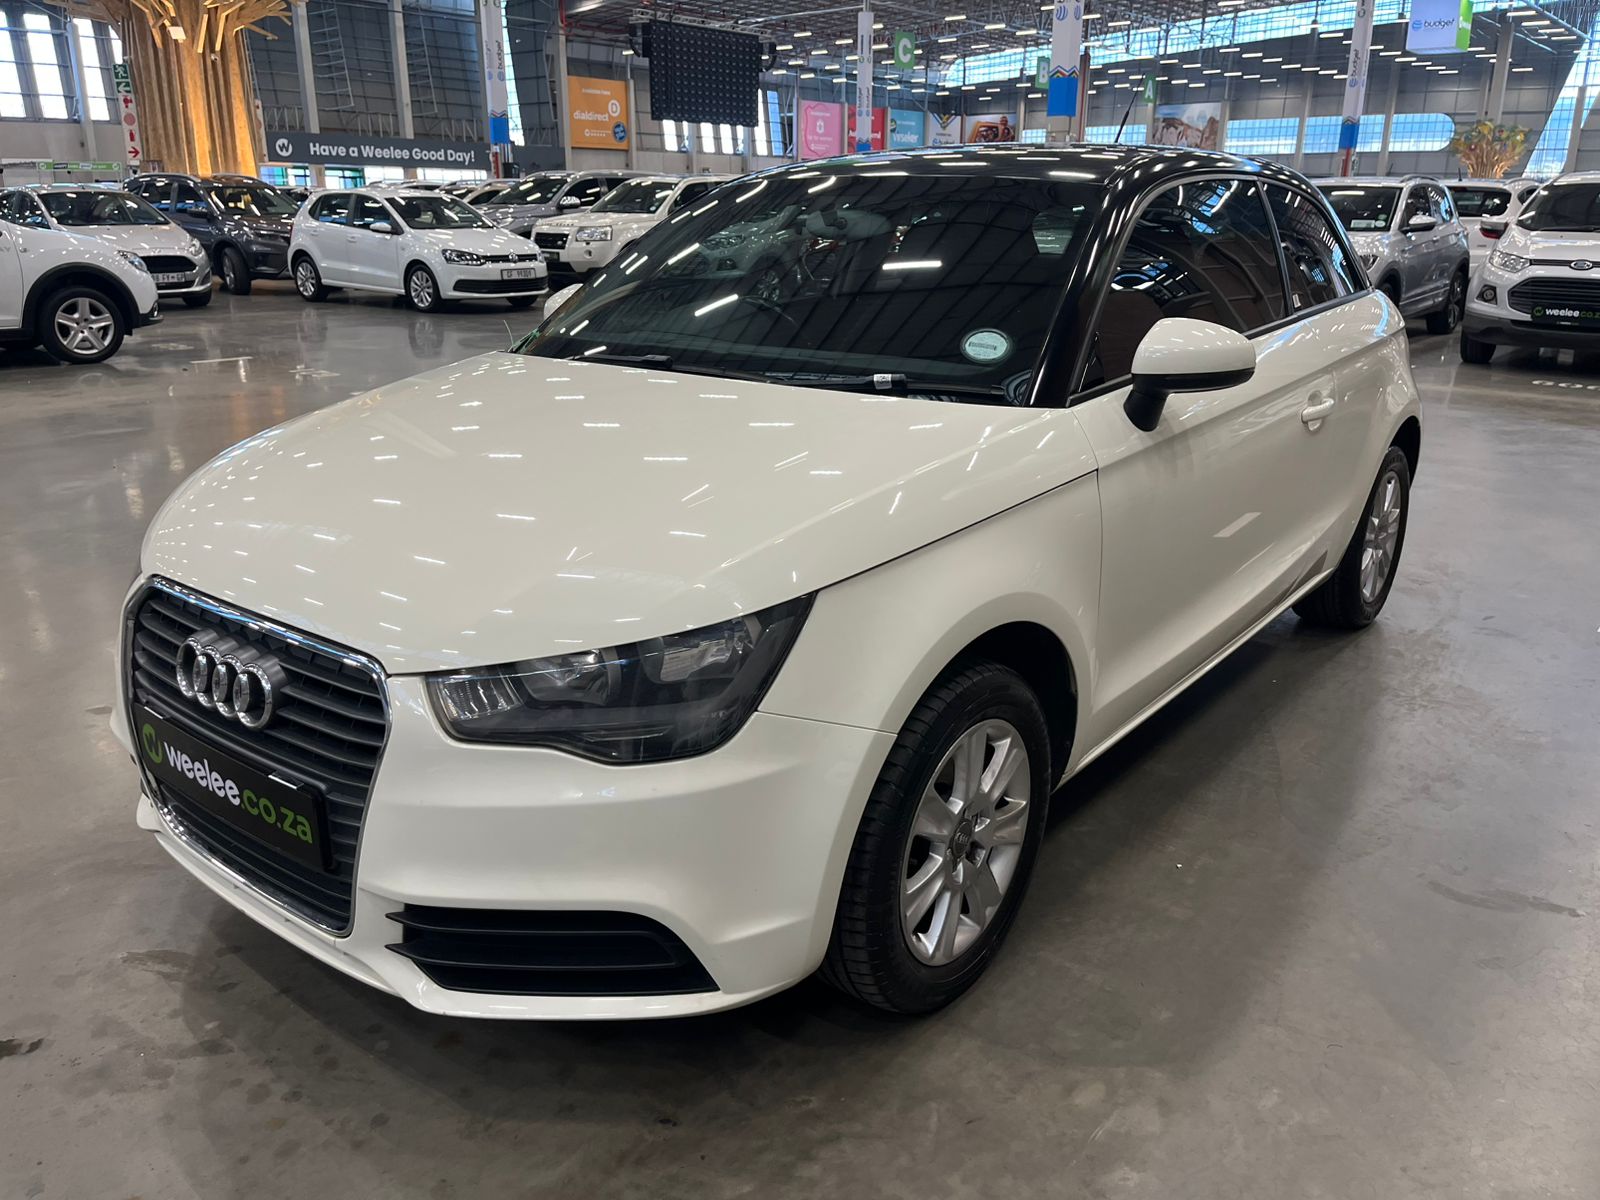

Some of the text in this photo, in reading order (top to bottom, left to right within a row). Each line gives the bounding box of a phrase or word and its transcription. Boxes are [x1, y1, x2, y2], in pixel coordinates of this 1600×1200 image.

[1424, 18, 1455, 30] budget
[899, 38, 912, 63] C
[1040, 61, 1049, 83] B
[1144, 79, 1153, 99] A
[573, 110, 609, 122] dialdirect
[309, 142, 346, 157] Have
[349, 148, 358, 157] a
[361, 145, 410, 160] Weelee
[412, 148, 445, 162] Good
[447, 149, 476, 165] Day!
[164, 742, 312, 843] weelee.co.za
